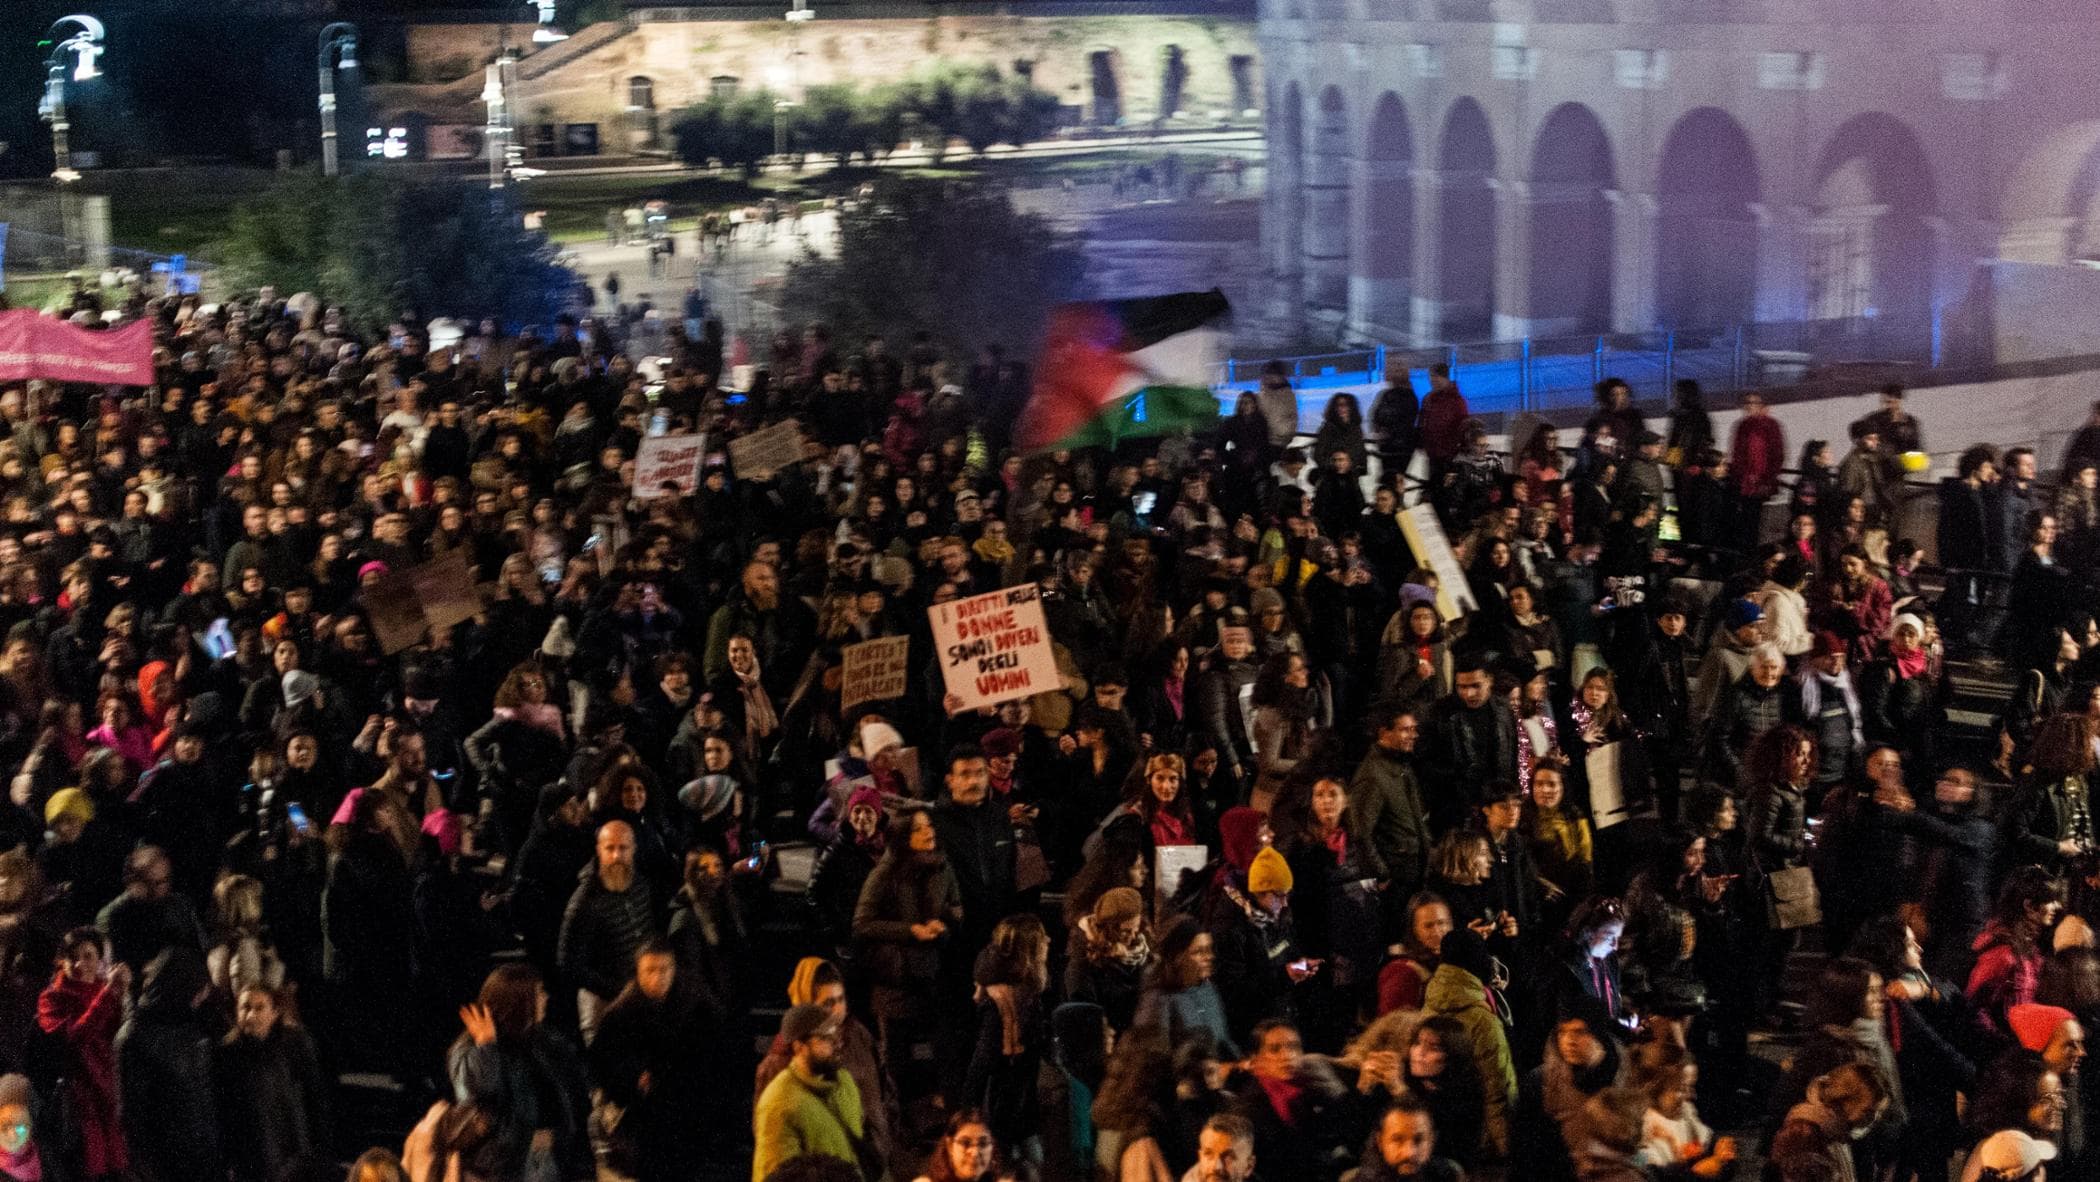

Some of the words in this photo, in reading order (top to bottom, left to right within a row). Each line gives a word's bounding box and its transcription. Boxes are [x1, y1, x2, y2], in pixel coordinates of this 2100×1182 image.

[955, 594, 1005, 620] DIRITTI
[1006, 587, 1037, 606] DELLE
[956, 610, 1018, 640] DONNE
[947, 639, 986, 667] SONO
[978, 651, 1018, 673] DEGLI
[976, 668, 1031, 696] UOMINI
